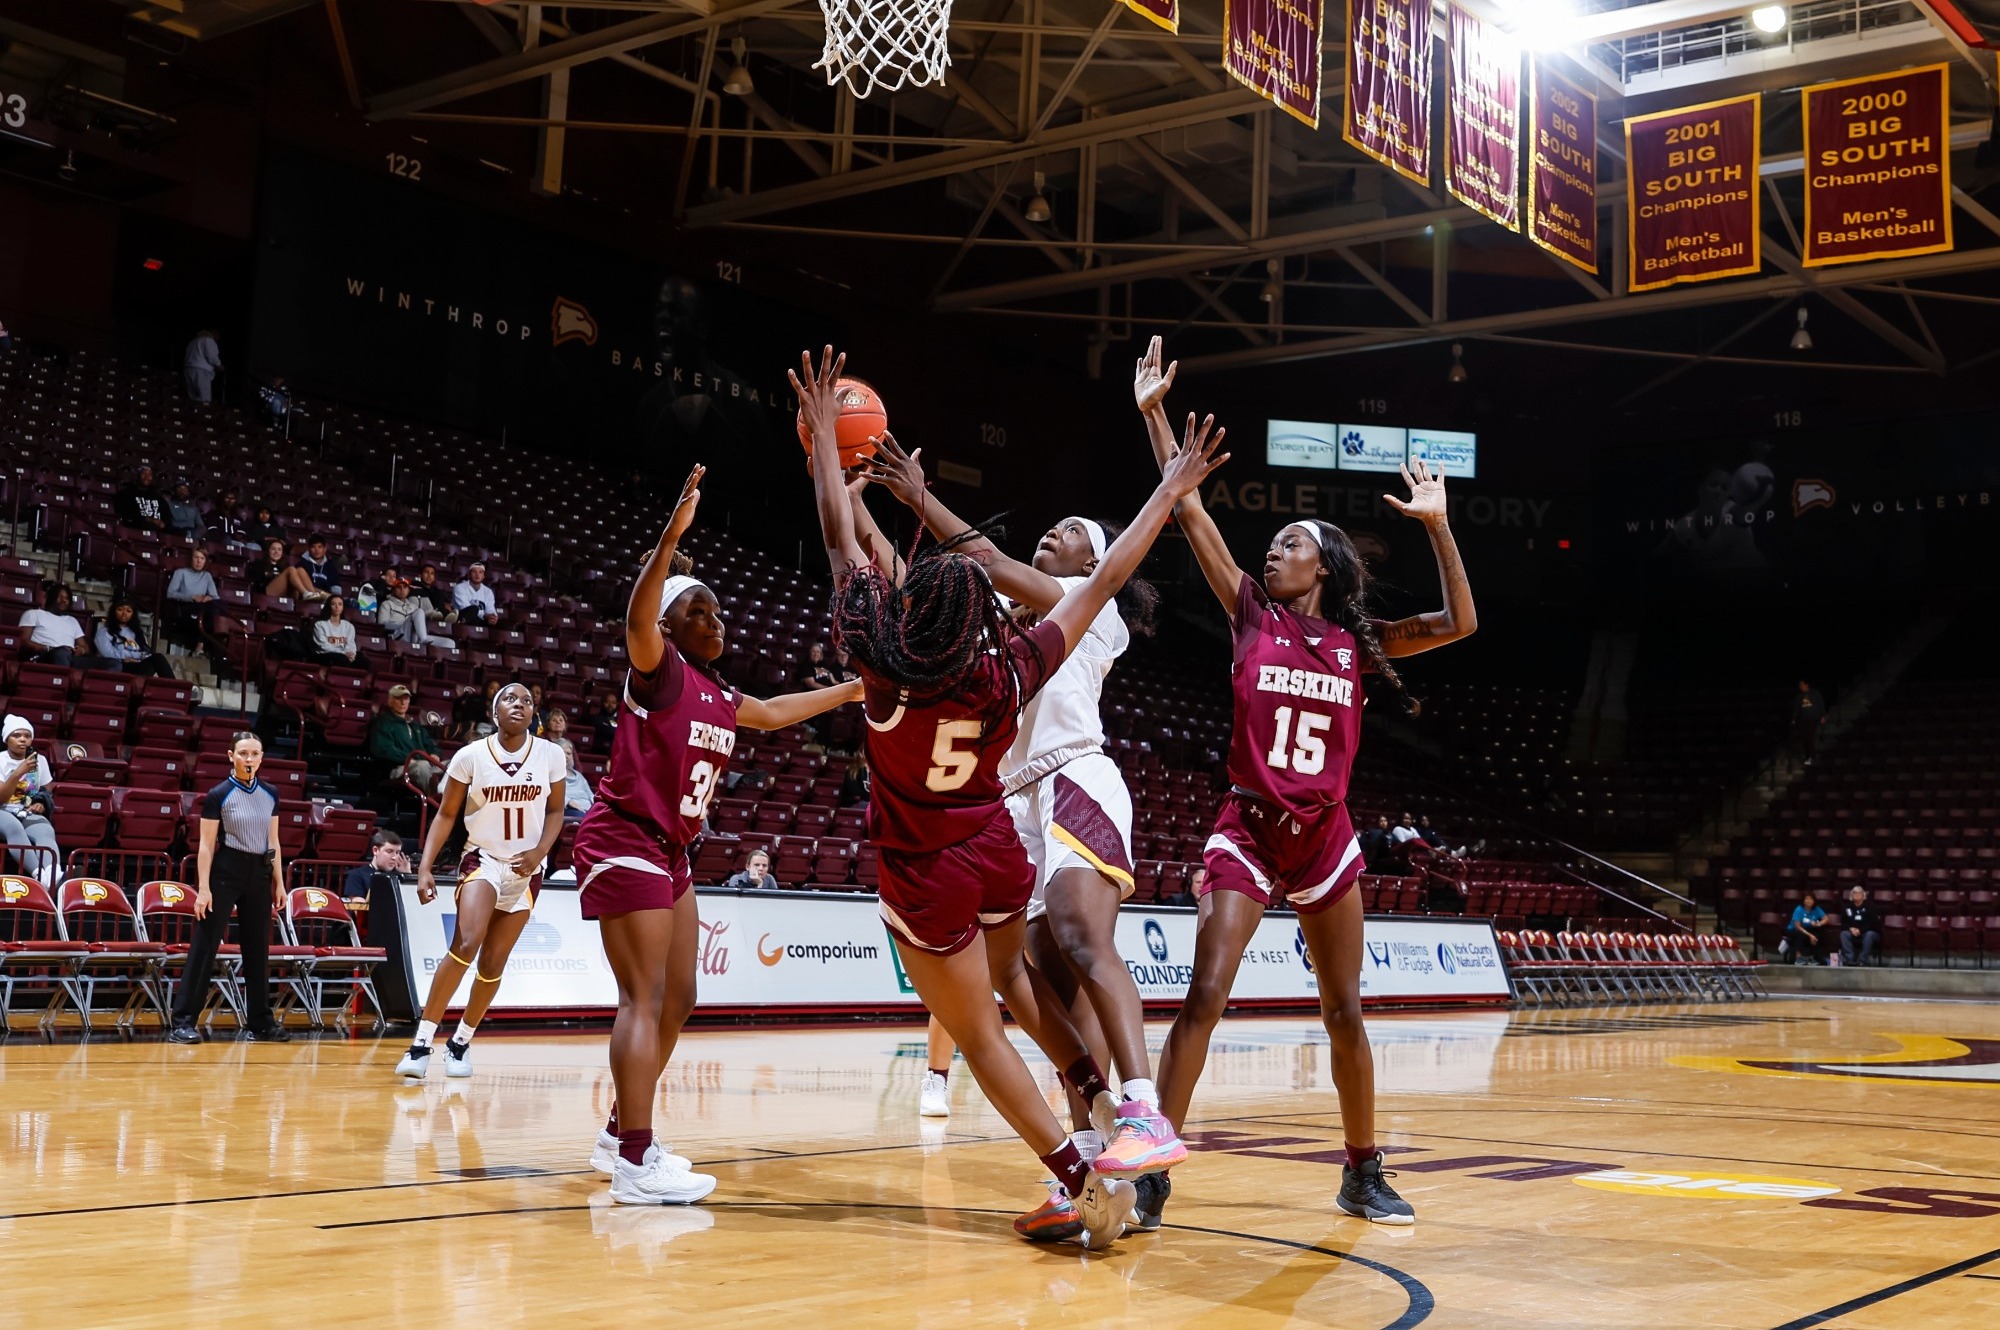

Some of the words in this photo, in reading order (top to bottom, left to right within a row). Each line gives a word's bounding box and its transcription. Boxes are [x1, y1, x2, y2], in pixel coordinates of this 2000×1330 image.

[1251, 29, 1294, 69] Men's
[1233, 38, 1311, 101] Basketball
[1551, 86, 1580, 118] 2002
[1841, 89, 1908, 116] 2000
[1552, 113, 1578, 141] BIG
[1664, 119, 1721, 145] 2001
[1848, 116, 1902, 139] BIG
[1539, 128, 1593, 173] SOUTH
[1668, 145, 1716, 168] BIG
[1820, 136, 1931, 167] SOUTH
[385, 152, 422, 182] 122
[1535, 151, 1594, 196] Champions
[1645, 164, 1742, 197] SOUTH
[1812, 162, 1940, 189] Champions
[1550, 201, 1582, 228] Men's
[1639, 188, 1749, 219] Champions
[1842, 207, 1909, 226] Men's
[1537, 210, 1593, 252] Basketball
[1665, 231, 1721, 251] Men's
[1816, 219, 1936, 245] Basketball
[1643, 242, 1744, 271] Basketball
[716, 260, 743, 285] 121
[346, 277, 531, 341] WINTHROP
[611, 350, 795, 413] BASKETBALL
[1358, 399, 1387, 414] 119
[1773, 411, 1802, 428] 118
[979, 421, 1007, 448] 120
[1626, 510, 1776, 534] WINTHROP
[1256, 664, 1355, 708] ERSKINE
[1266, 705, 1332, 776] 15
[925, 718, 984, 793] 5
[481, 784, 542, 803] WINTHROP
[503, 807, 525, 840] 11
[786, 941, 878, 964] comporium
[1260, 950, 1291, 964] NEST
[1390, 942, 1429, 957] Williams
[1452, 943, 1467, 955] York
[1468, 943, 1493, 958] County
[1456, 955, 1480, 967] Natural
[1481, 955, 1496, 968] Gas
[507, 958, 588, 971] RIBUTORS
